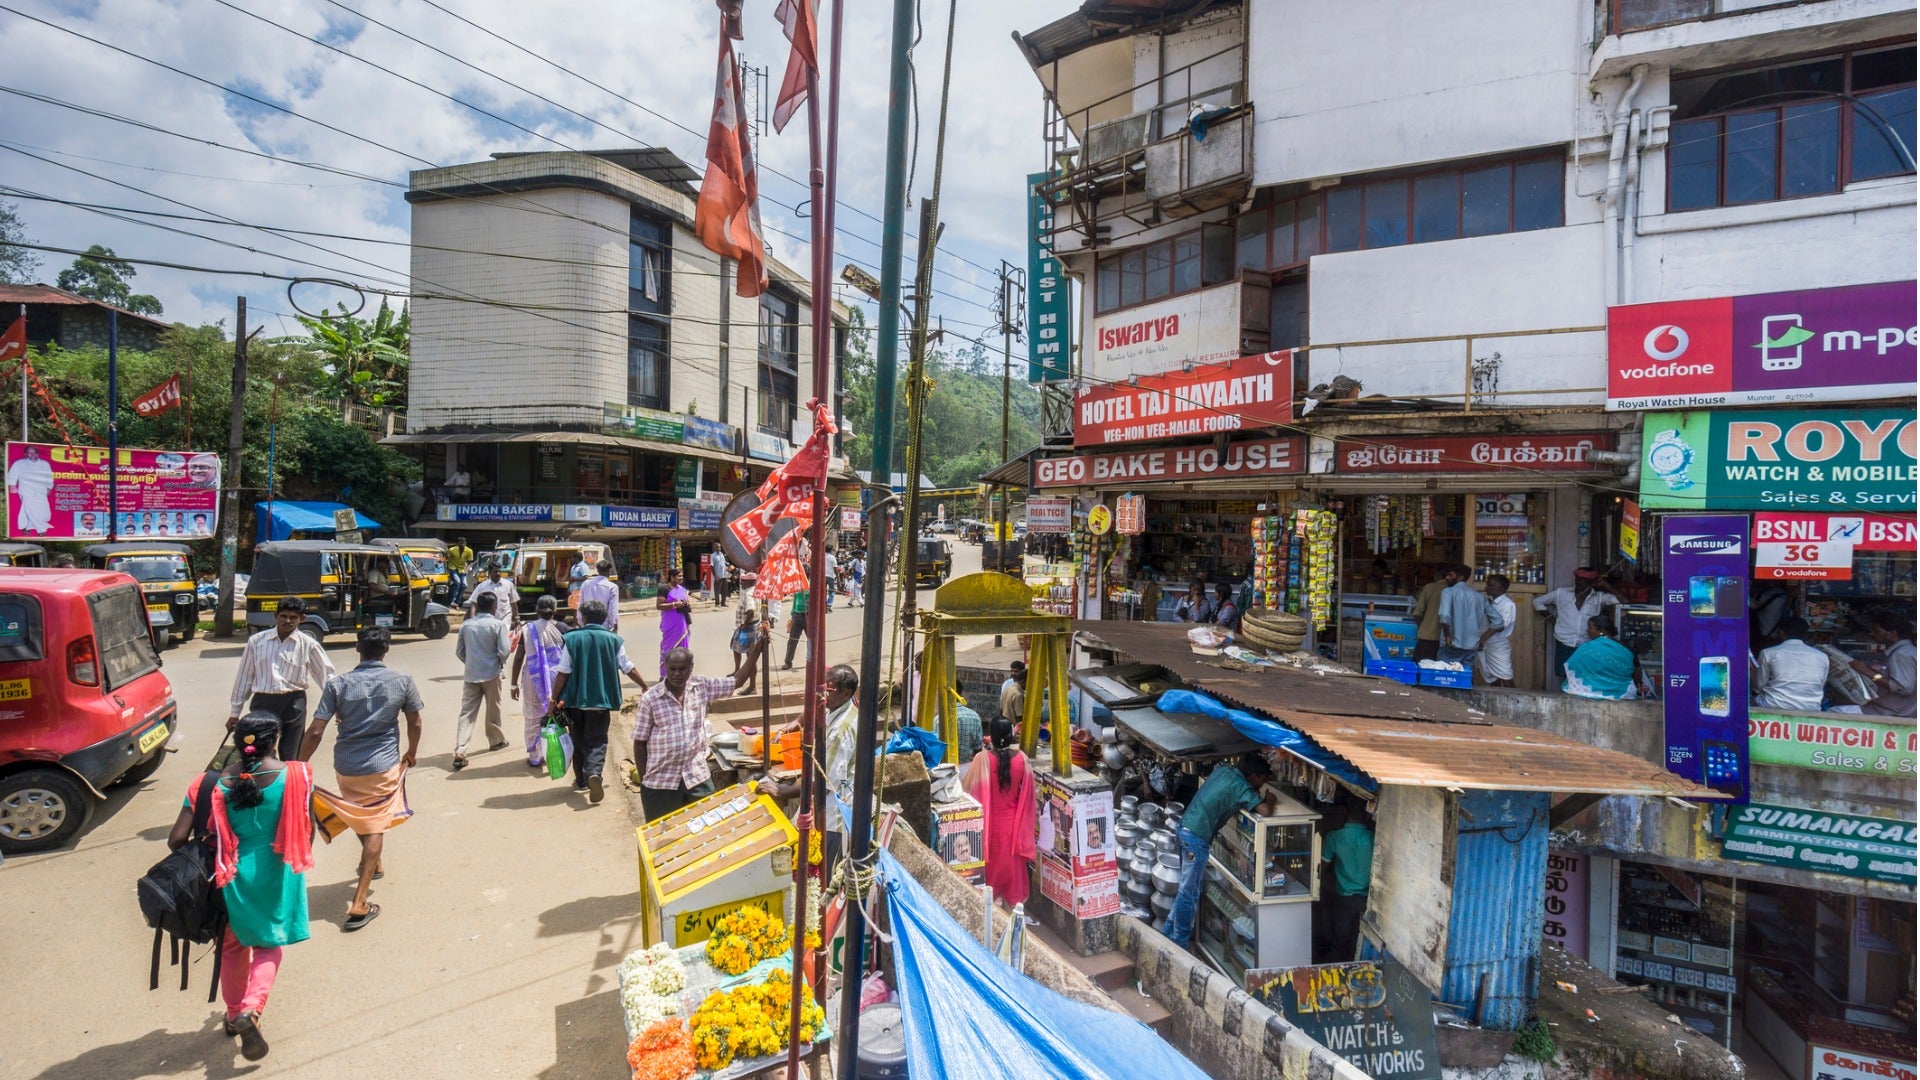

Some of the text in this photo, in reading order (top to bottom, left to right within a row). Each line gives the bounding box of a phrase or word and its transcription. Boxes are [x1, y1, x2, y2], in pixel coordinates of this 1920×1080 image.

[1037, 313, 1060, 369] HOME
[1098, 314, 1179, 351] Iswarya
[1619, 362, 1715, 379] vodafone
[1081, 373, 1273, 426] HOTEL TAJ HAYAATH
[1617, 399, 1648, 410] Royal
[1651, 396, 1686, 407] Watch
[1689, 395, 1726, 405] House
[1104, 414, 1242, 443] VEG-NON VEG-HALAL FOODS
[51, 447, 132, 465] CPI
[1038, 442, 1291, 482] GEO BAKE HOUSE
[1725, 466, 1799, 481] WATCH
[1807, 466, 1825, 482] &
[1761, 490, 1820, 504] Sales
[1828, 491, 1846, 504] &
[458, 505, 551, 515] INDIAN BAKERY
[609, 511, 672, 523] INDIAN BAKERY
[1757, 520, 1822, 540] BSNL
[1679, 540, 1732, 550] SAMSUNG
[1783, 545, 1819, 562] 3G
[1786, 569, 1828, 577] vodafone
[1668, 594, 1684, 603] E5
[1671, 679, 1686, 687] E7
[1797, 723, 1875, 748] WATCH
[1883, 732, 1897, 750] &
[1670, 750, 1693, 758] TIZEN
[1811, 751, 1866, 770] Sales
[1874, 756, 1888, 772] &
[1749, 828, 1860, 850] IMMITATION
[1325, 1021, 1389, 1050] WATCH
[1365, 1050, 1425, 1076] WORKS
